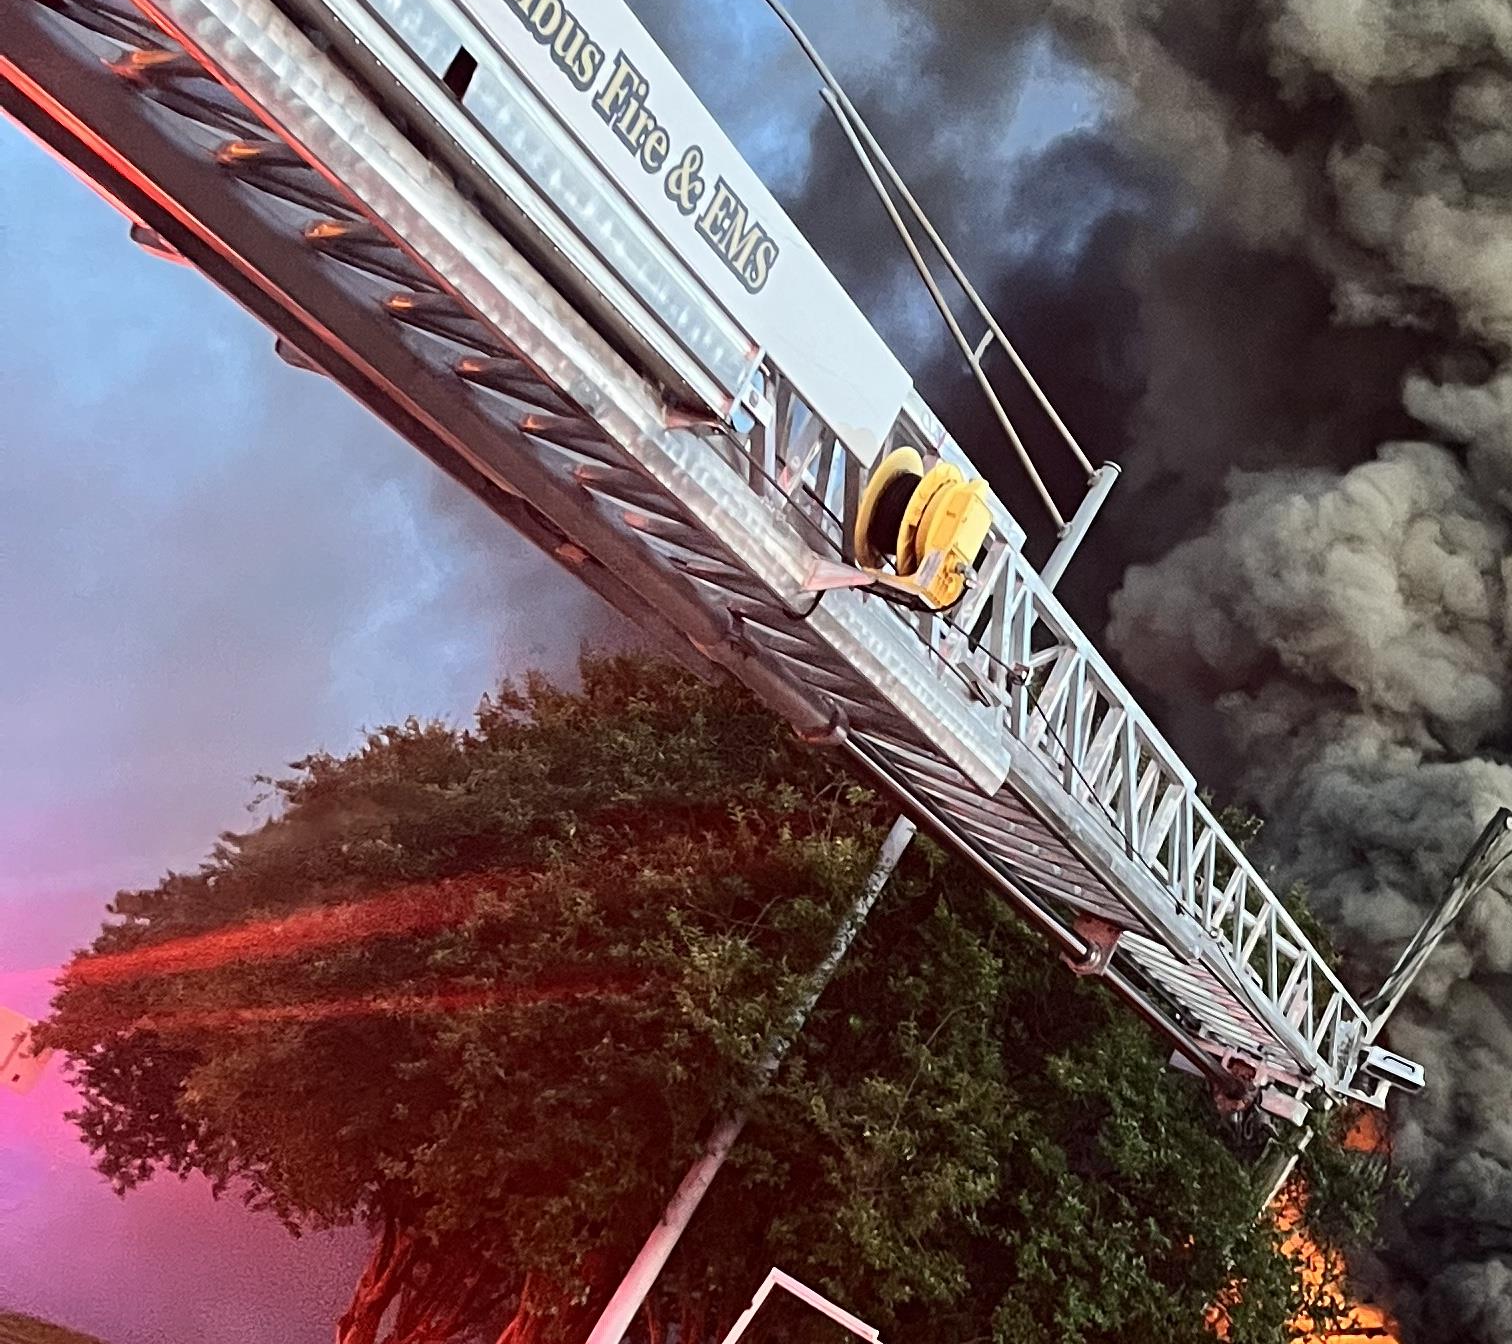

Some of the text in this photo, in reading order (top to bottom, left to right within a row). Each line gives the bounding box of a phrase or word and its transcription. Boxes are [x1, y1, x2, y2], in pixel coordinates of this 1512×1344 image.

[592, 48, 670, 174] Fire
[664, 145, 705, 216] &
[695, 175, 779, 294] EMS
